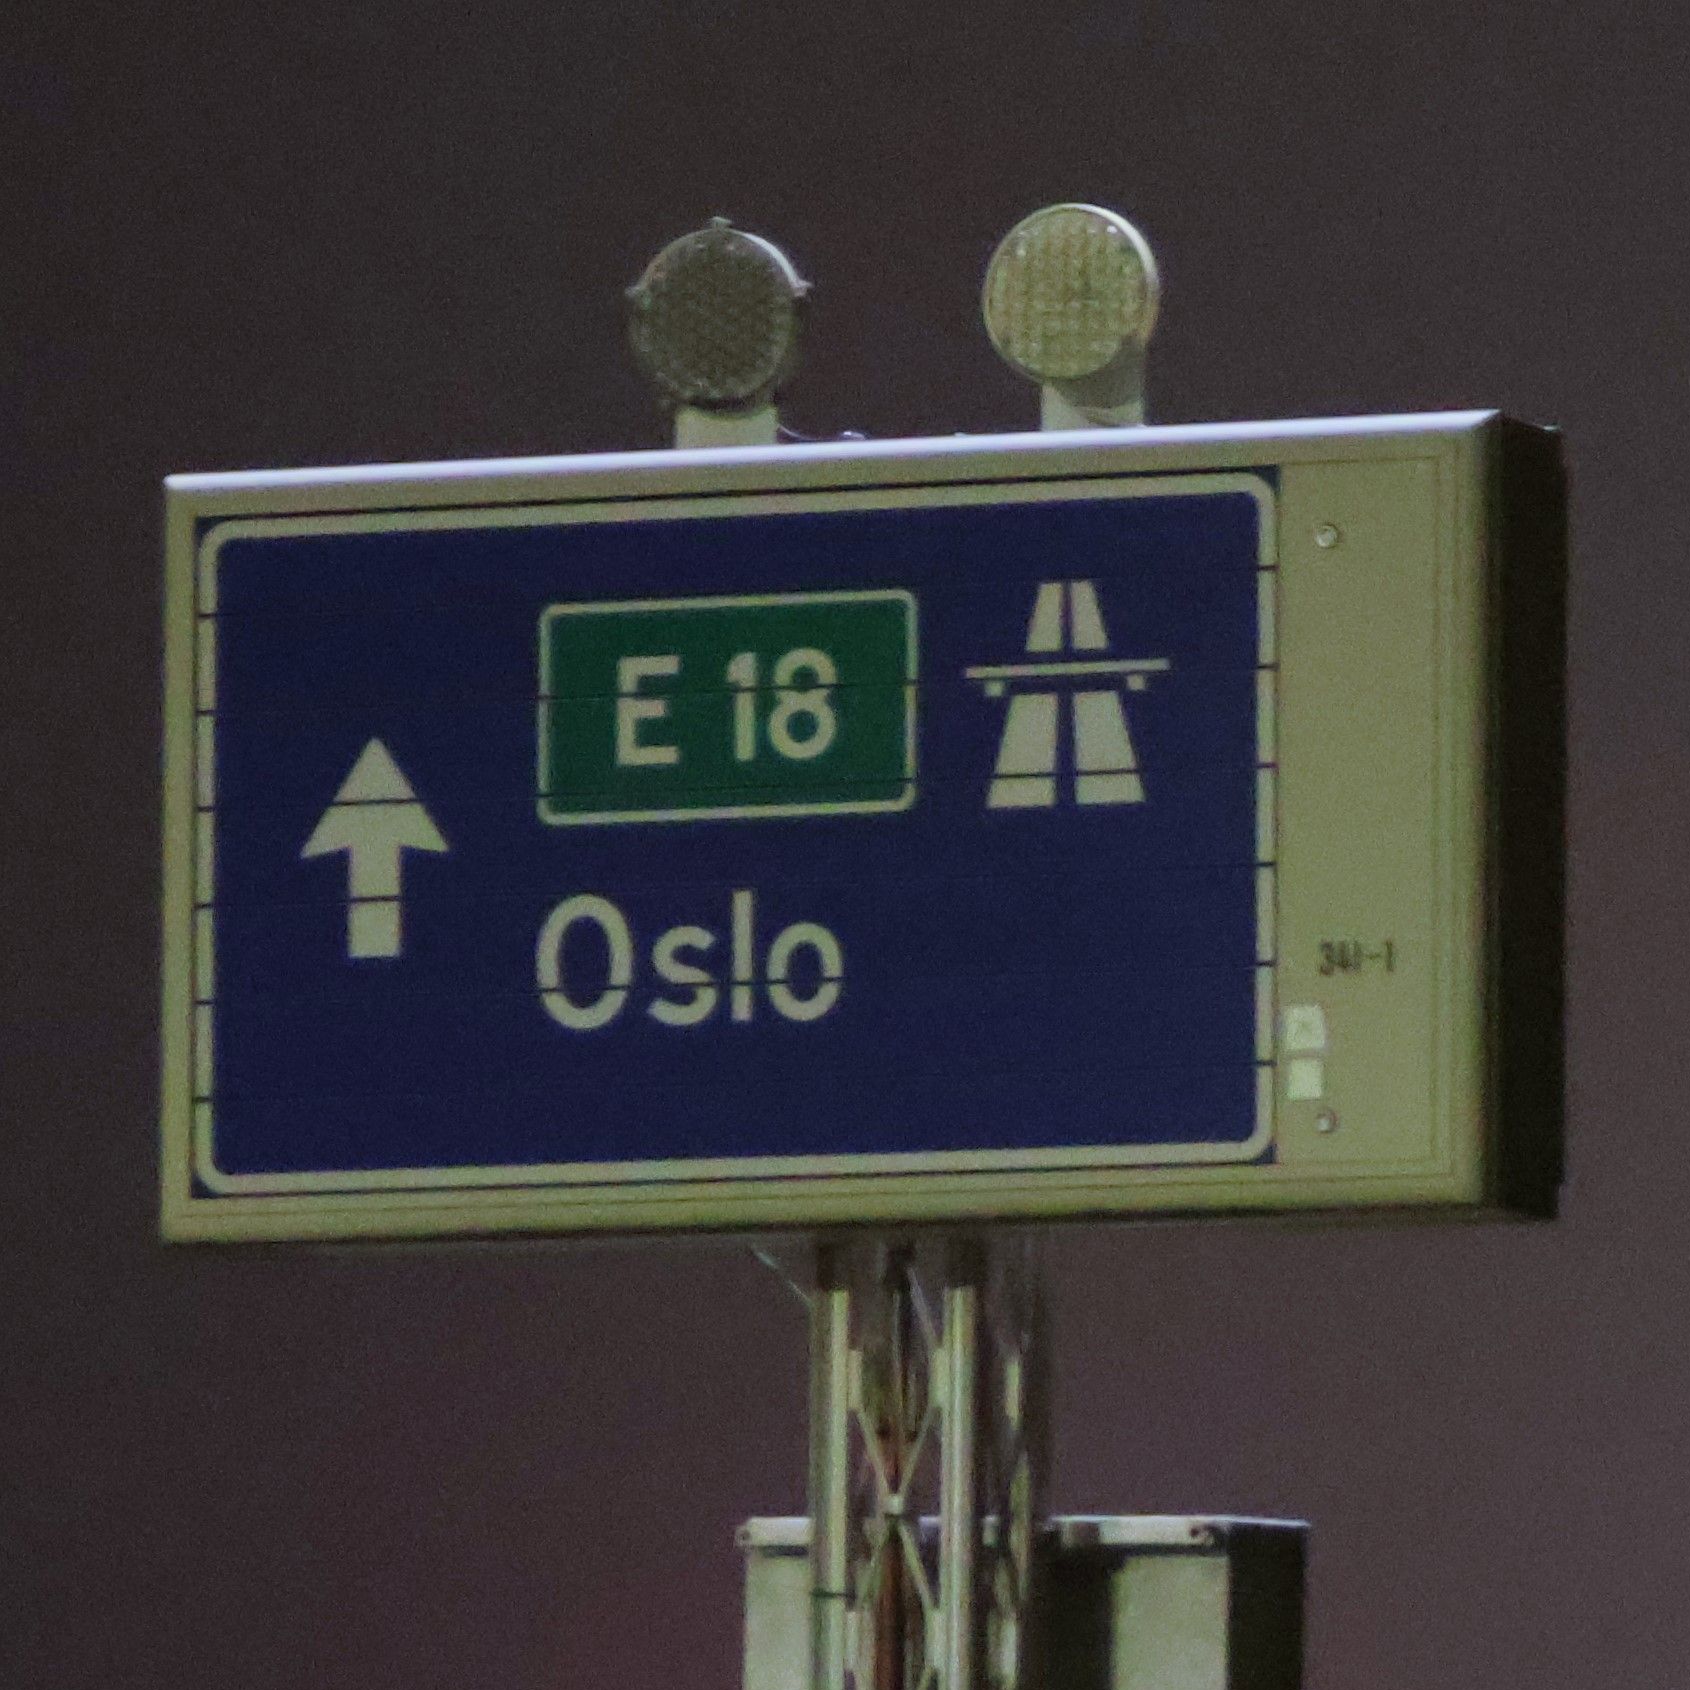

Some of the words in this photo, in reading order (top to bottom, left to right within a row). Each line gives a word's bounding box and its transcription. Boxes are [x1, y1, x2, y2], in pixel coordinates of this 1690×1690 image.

[616, 655, 681, 766] E
[727, 648, 838, 761] 18
[536, 890, 844, 1030] Oslo
